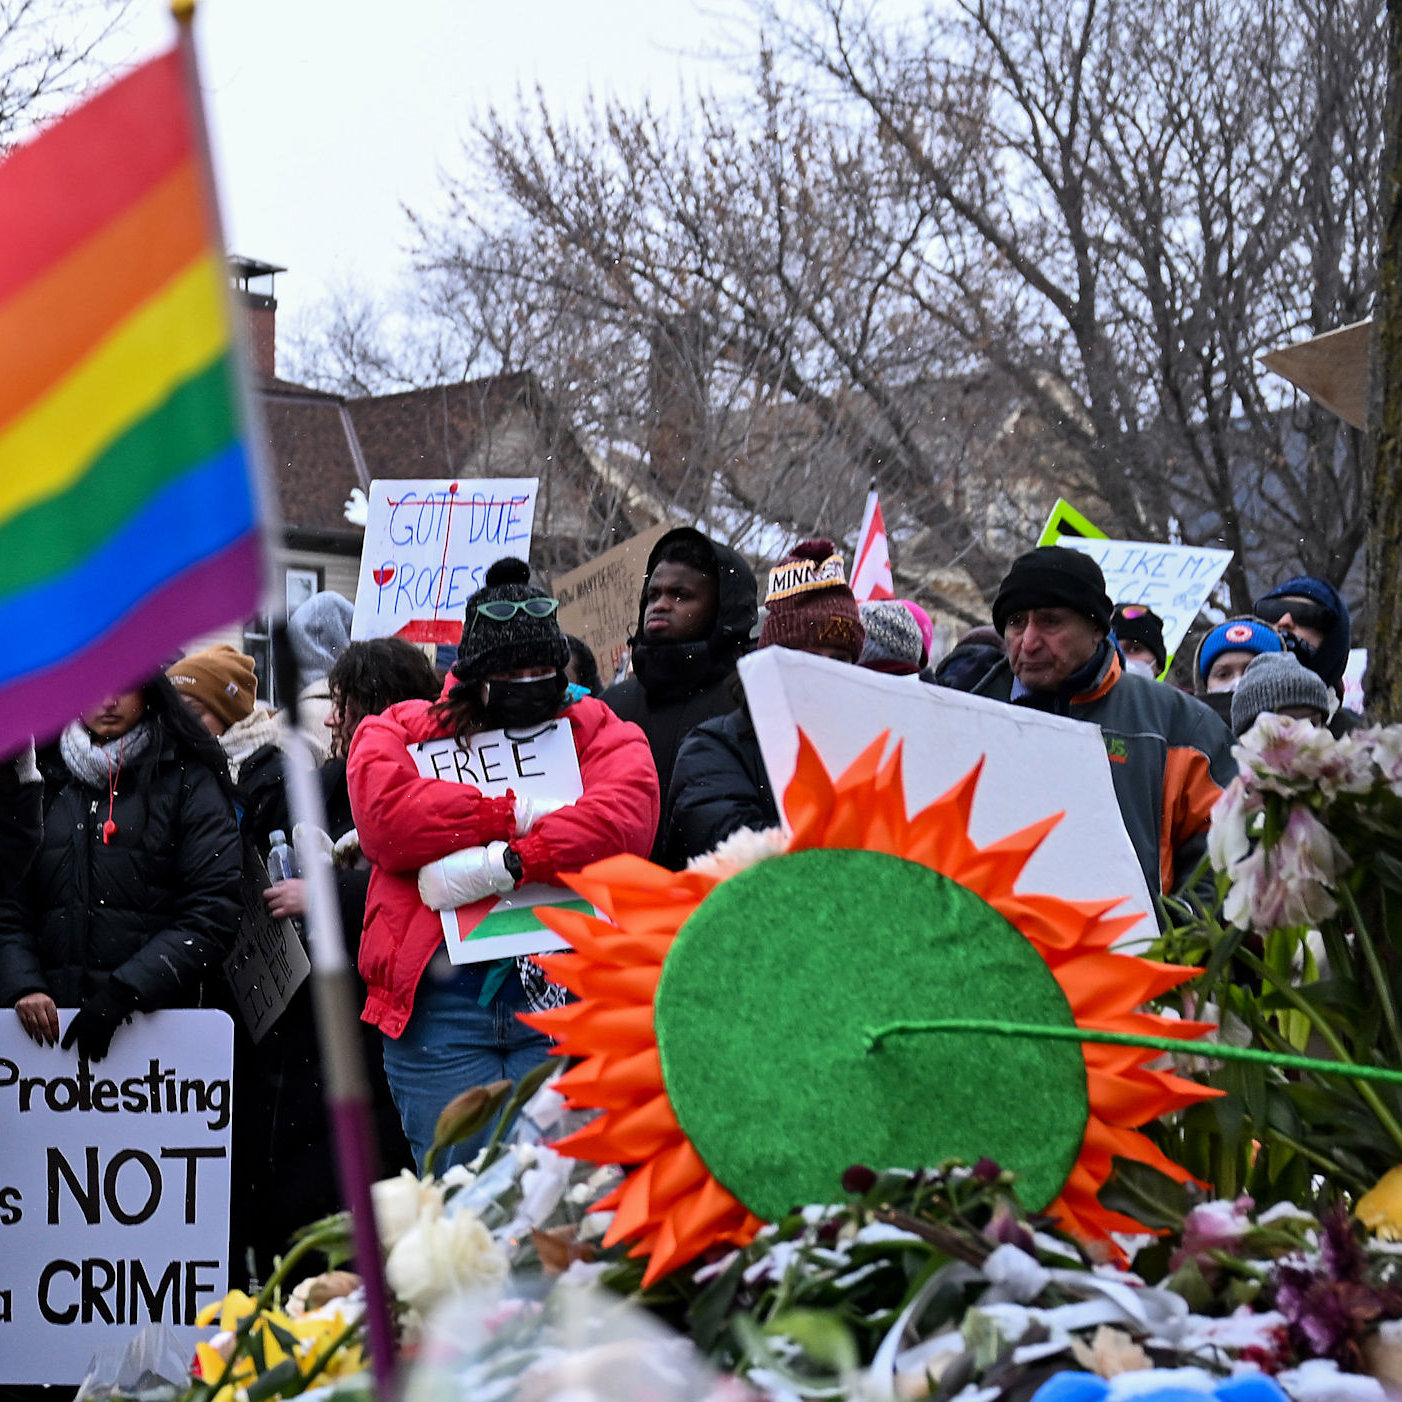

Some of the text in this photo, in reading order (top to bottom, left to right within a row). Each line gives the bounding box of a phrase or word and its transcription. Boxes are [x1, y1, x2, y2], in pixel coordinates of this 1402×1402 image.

[389, 491, 529, 546] GOT DUE
[377, 560, 488, 615] PROCES
[1101, 548, 1222, 579] LIKE MY
[1107, 577, 1169, 606] CE
[430, 738, 546, 783] FREE
[46, 1146, 227, 1226] NOT
[37, 1258, 220, 1326] CRIME
